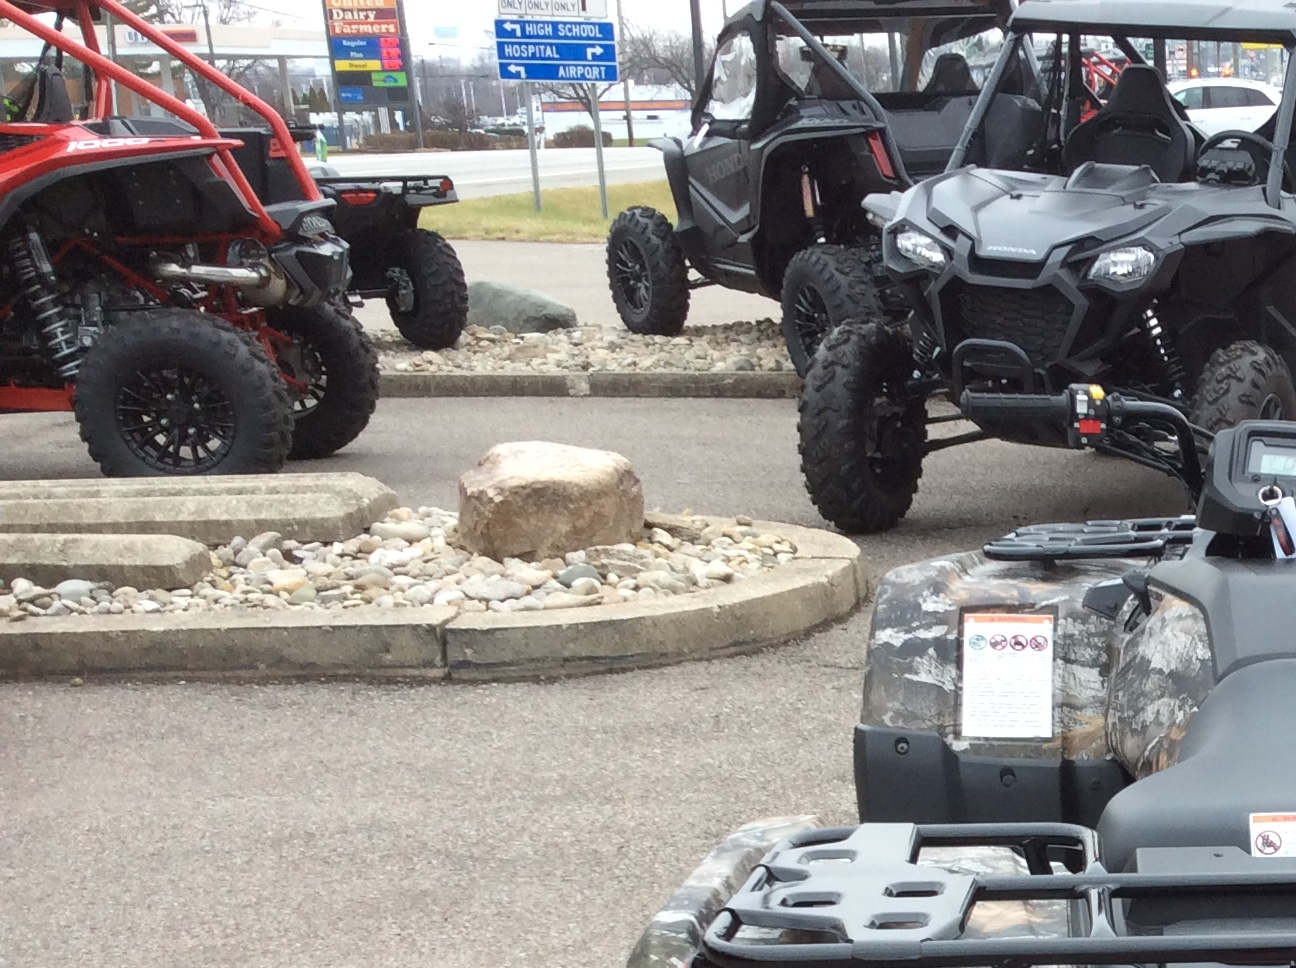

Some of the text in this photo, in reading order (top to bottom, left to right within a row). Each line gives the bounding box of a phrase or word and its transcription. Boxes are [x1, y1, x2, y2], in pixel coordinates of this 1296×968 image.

[501, 0, 523, 9] ONLY
[527, 0, 549, 10] ONLY
[554, 1, 576, 12] ONLY
[332, 9, 376, 21] Dairy
[334, 22, 396, 34] Farmers
[525, 23, 603, 37] HIGH SCHOOL
[504, 44, 560, 58] HOSPITAL
[558, 66, 606, 79] AIRPORT
[986, 246, 1037, 255] HONDA
